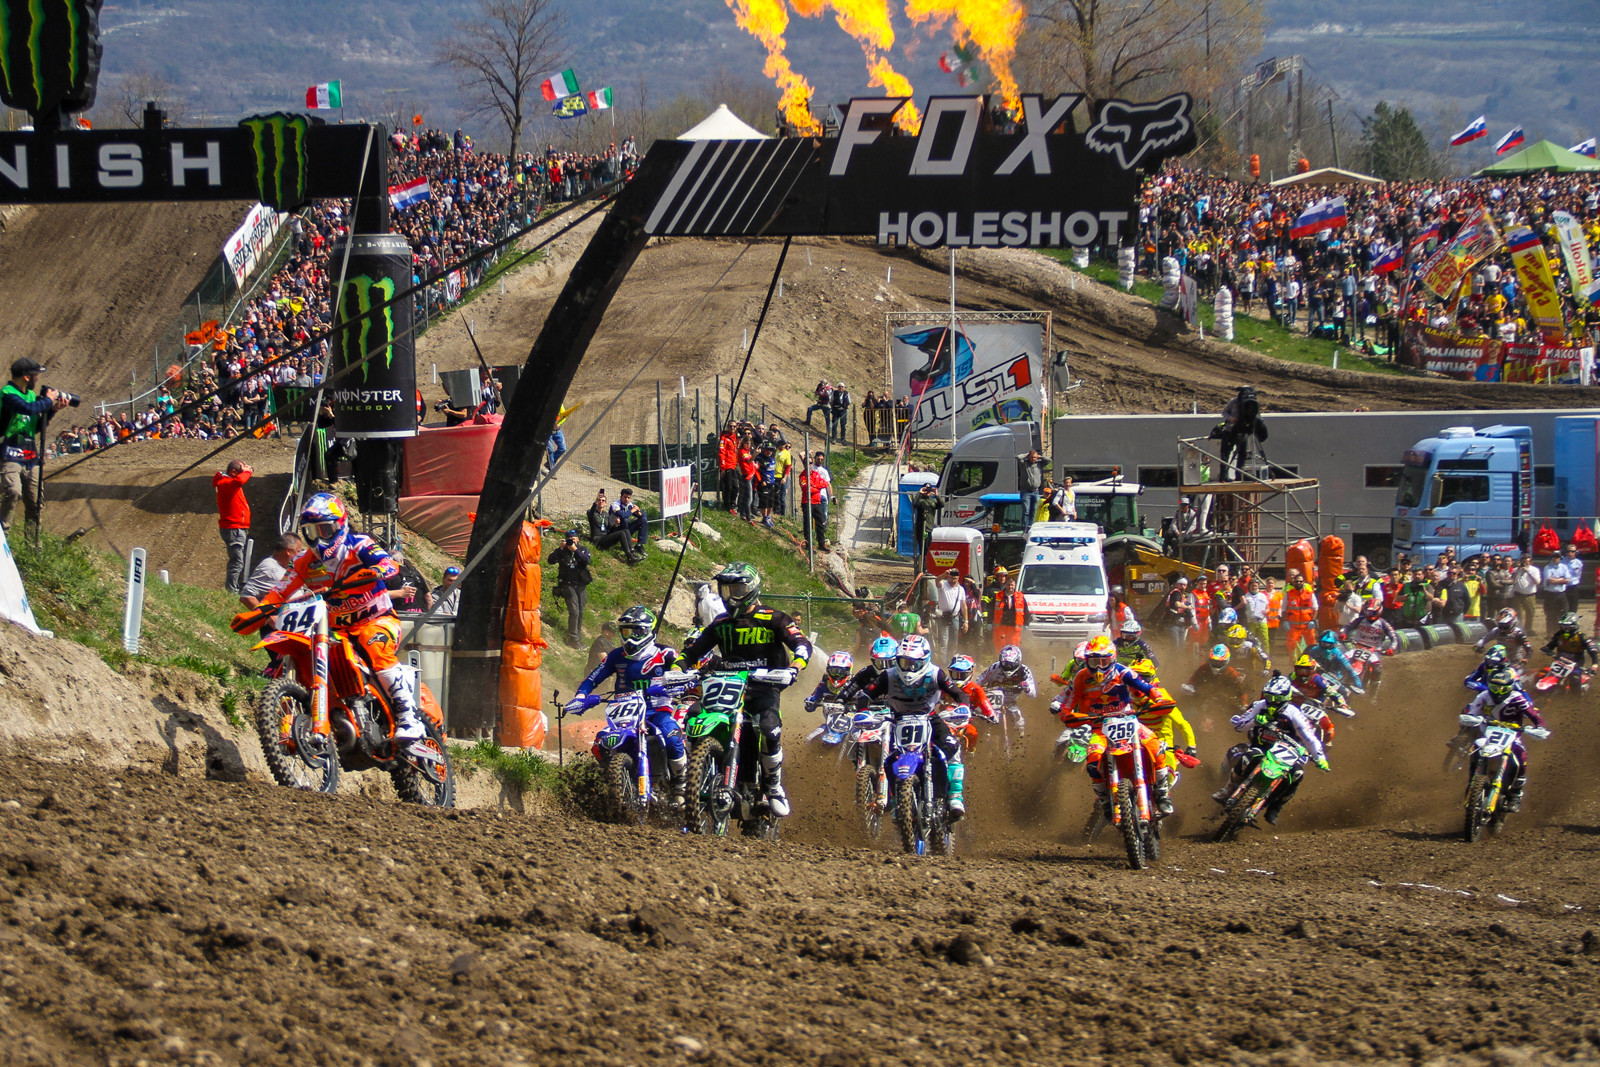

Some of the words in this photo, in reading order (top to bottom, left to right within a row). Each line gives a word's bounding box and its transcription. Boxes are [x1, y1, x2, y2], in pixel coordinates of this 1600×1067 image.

[829, 96, 1079, 175] FOX
[878, 211, 1128, 247] HOLESHOT
[1424, 347, 1483, 358] POLJANSKI
[1545, 348, 1580, 359] MAKOL
[1426, 360, 1477, 372] NAVIJAČI
[334, 388, 403, 404] MONSTER
[911, 353, 1032, 435] JUST1
[943, 510, 976, 519] MXGP
[1479, 543, 1519, 553] MXGP
[133, 557, 143, 584] UFO
[1147, 582, 1165, 593] CAT
[347, 590, 375, 610] Bull
[281, 605, 317, 633] 84
[335, 604, 379, 626] KTM
[724, 658, 768, 669] Kawasaki
[1551, 663, 1568, 676] 31
[703, 682, 741, 706] 25
[1302, 705, 1324, 718] 471
[901, 725, 924, 745] 91
[1107, 722, 1135, 740] 259
[1489, 730, 1508, 746] 21
[1270, 744, 1299, 760] 77
